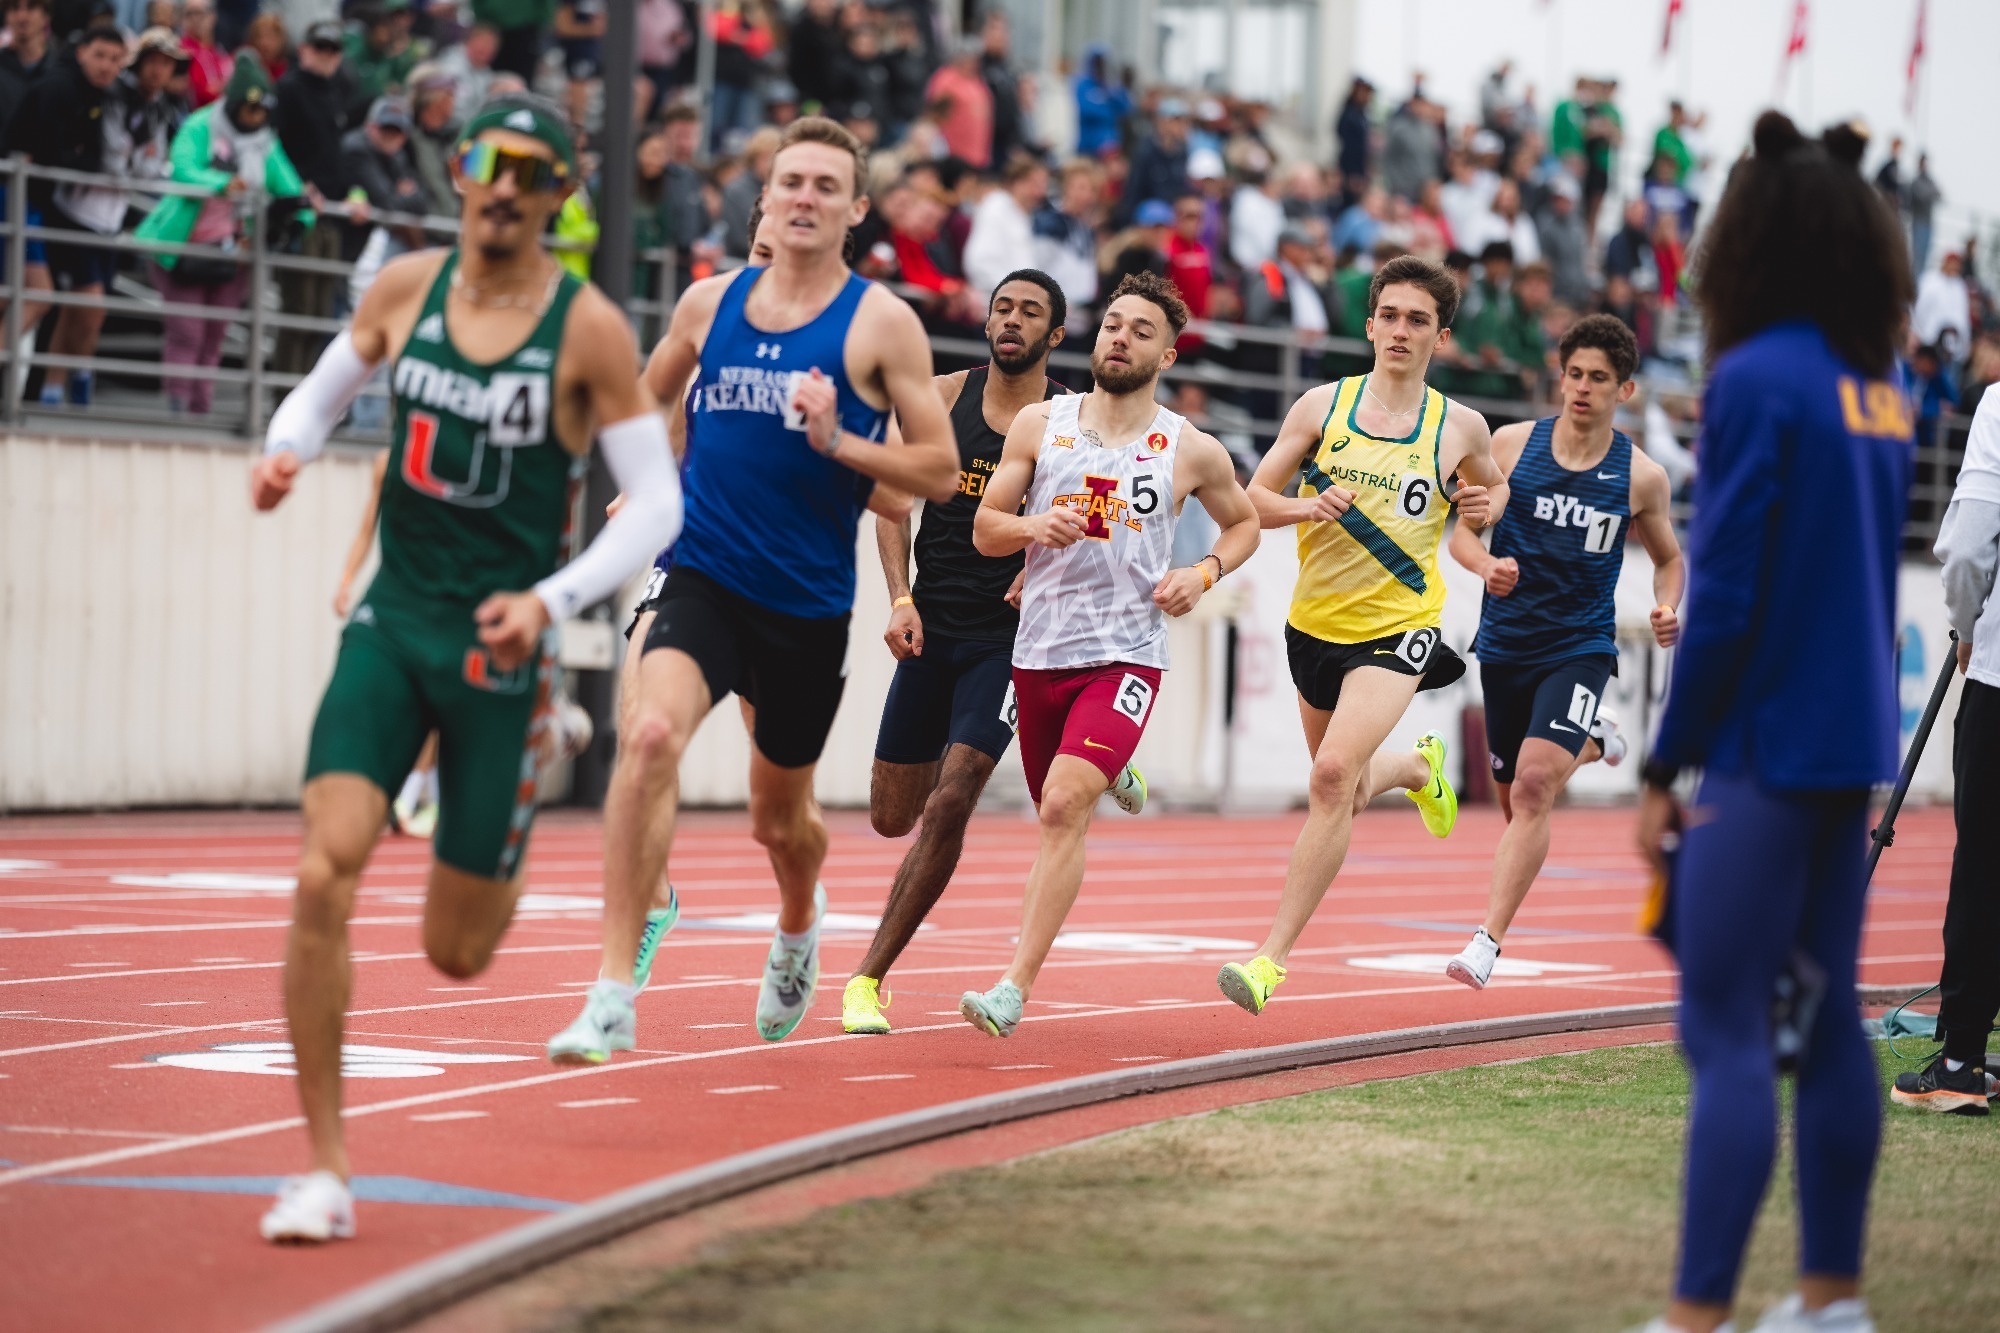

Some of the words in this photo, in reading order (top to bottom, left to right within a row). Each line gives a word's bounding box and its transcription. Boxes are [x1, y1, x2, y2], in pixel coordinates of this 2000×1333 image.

[717, 366, 790, 389] NEBRAS
[503, 385, 532, 435] 4
[704, 383, 789, 417] KEARN
[972, 458, 998, 473] ST-LA
[1329, 465, 1402, 493] AUSTRALI
[956, 470, 987, 497] SEL
[1131, 474, 1159, 515] 5
[1403, 478, 1430, 516] 6
[1533, 493, 1595, 528] BYU
[1597, 517, 1612, 551] 1
[1406, 628, 1433, 664] 6
[1120, 679, 1148, 717] 5
[1580, 693, 1590, 725] 1
